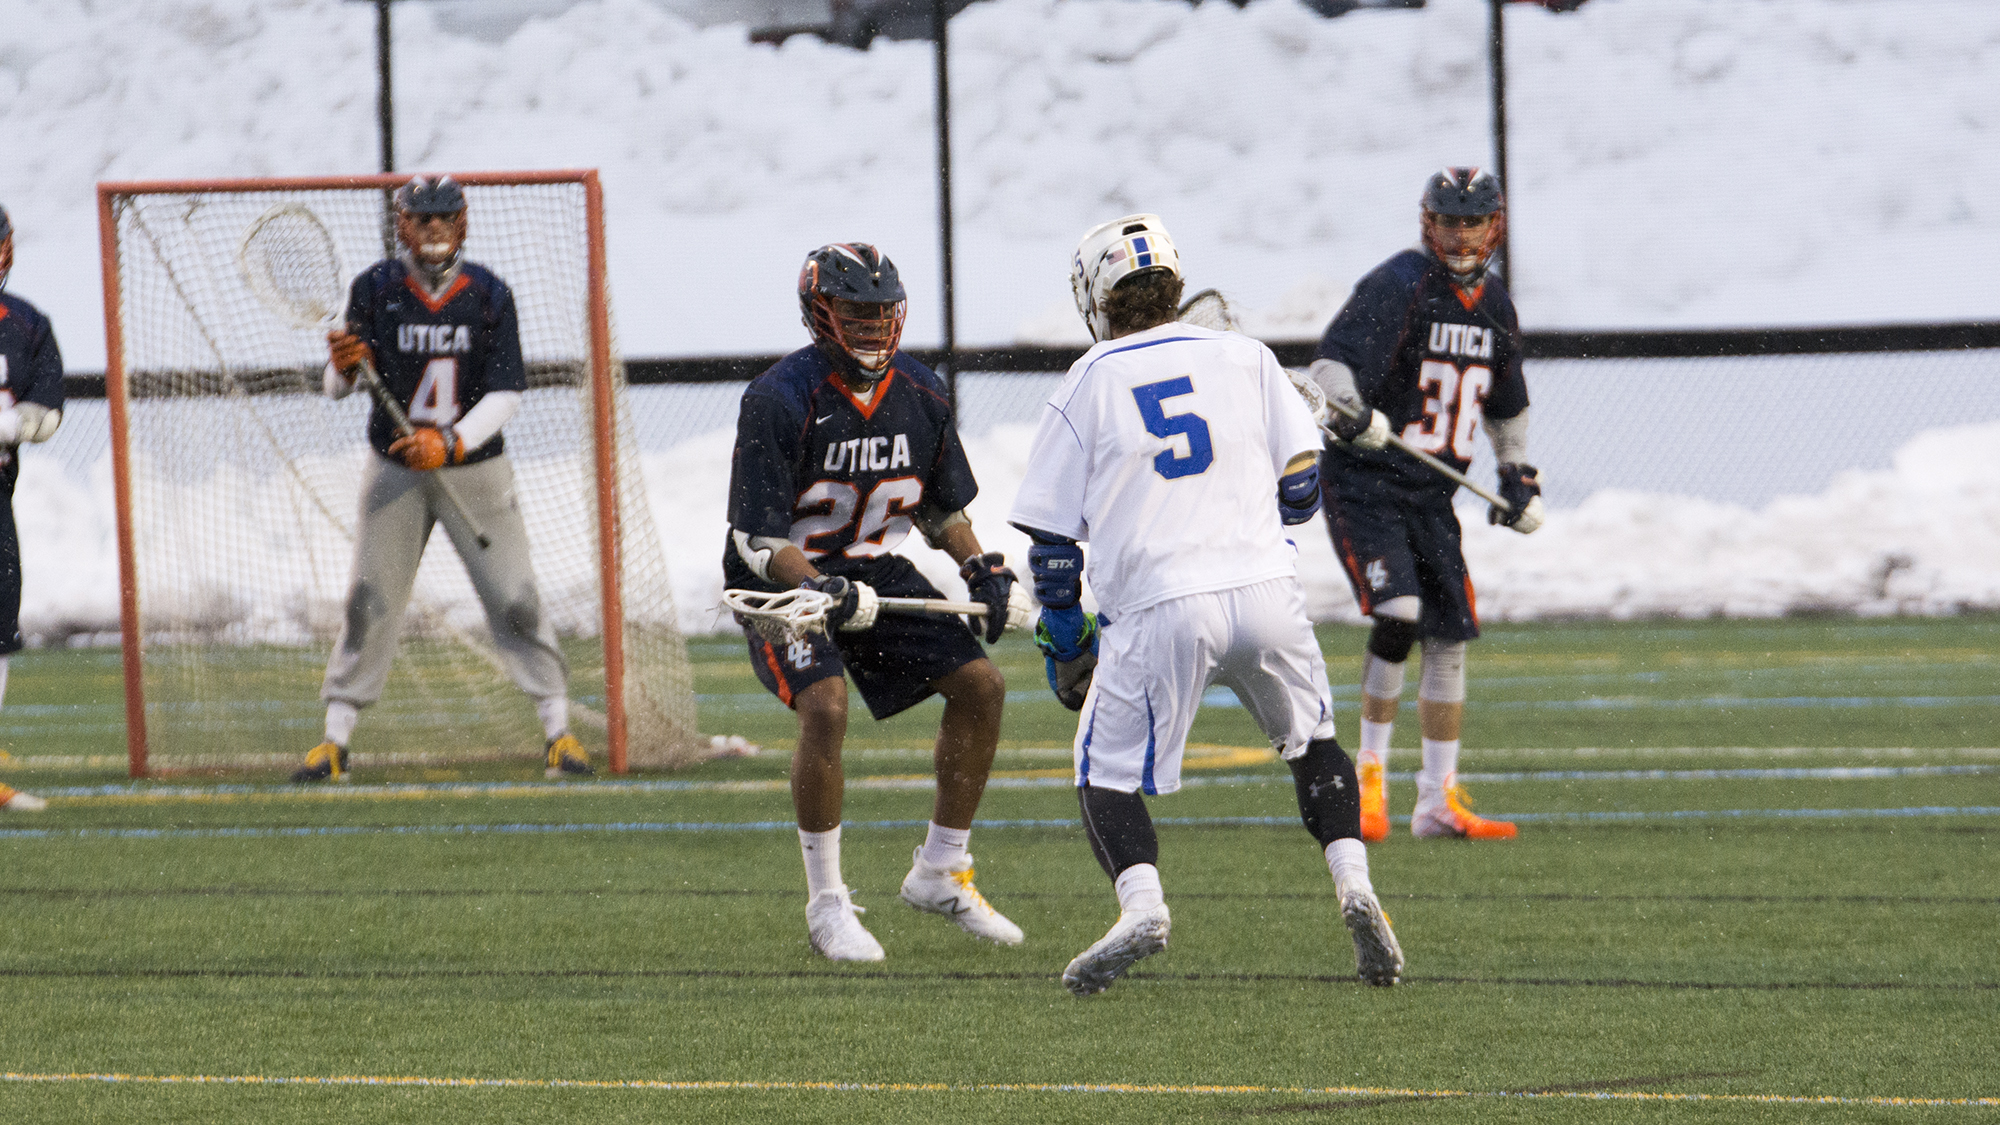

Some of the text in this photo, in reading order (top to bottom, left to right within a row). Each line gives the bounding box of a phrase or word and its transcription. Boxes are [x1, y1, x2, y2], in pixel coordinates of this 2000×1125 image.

[397, 323, 471, 353] UTICA
[1428, 321, 1493, 359] UTICA
[407, 357, 461, 427] 4
[1400, 358, 1493, 461] 36
[823, 433, 911, 473] UTICA
[1127, 372, 1217, 483] 5
[788, 475, 924, 559] 26
[1047, 558, 1076, 569] STX
